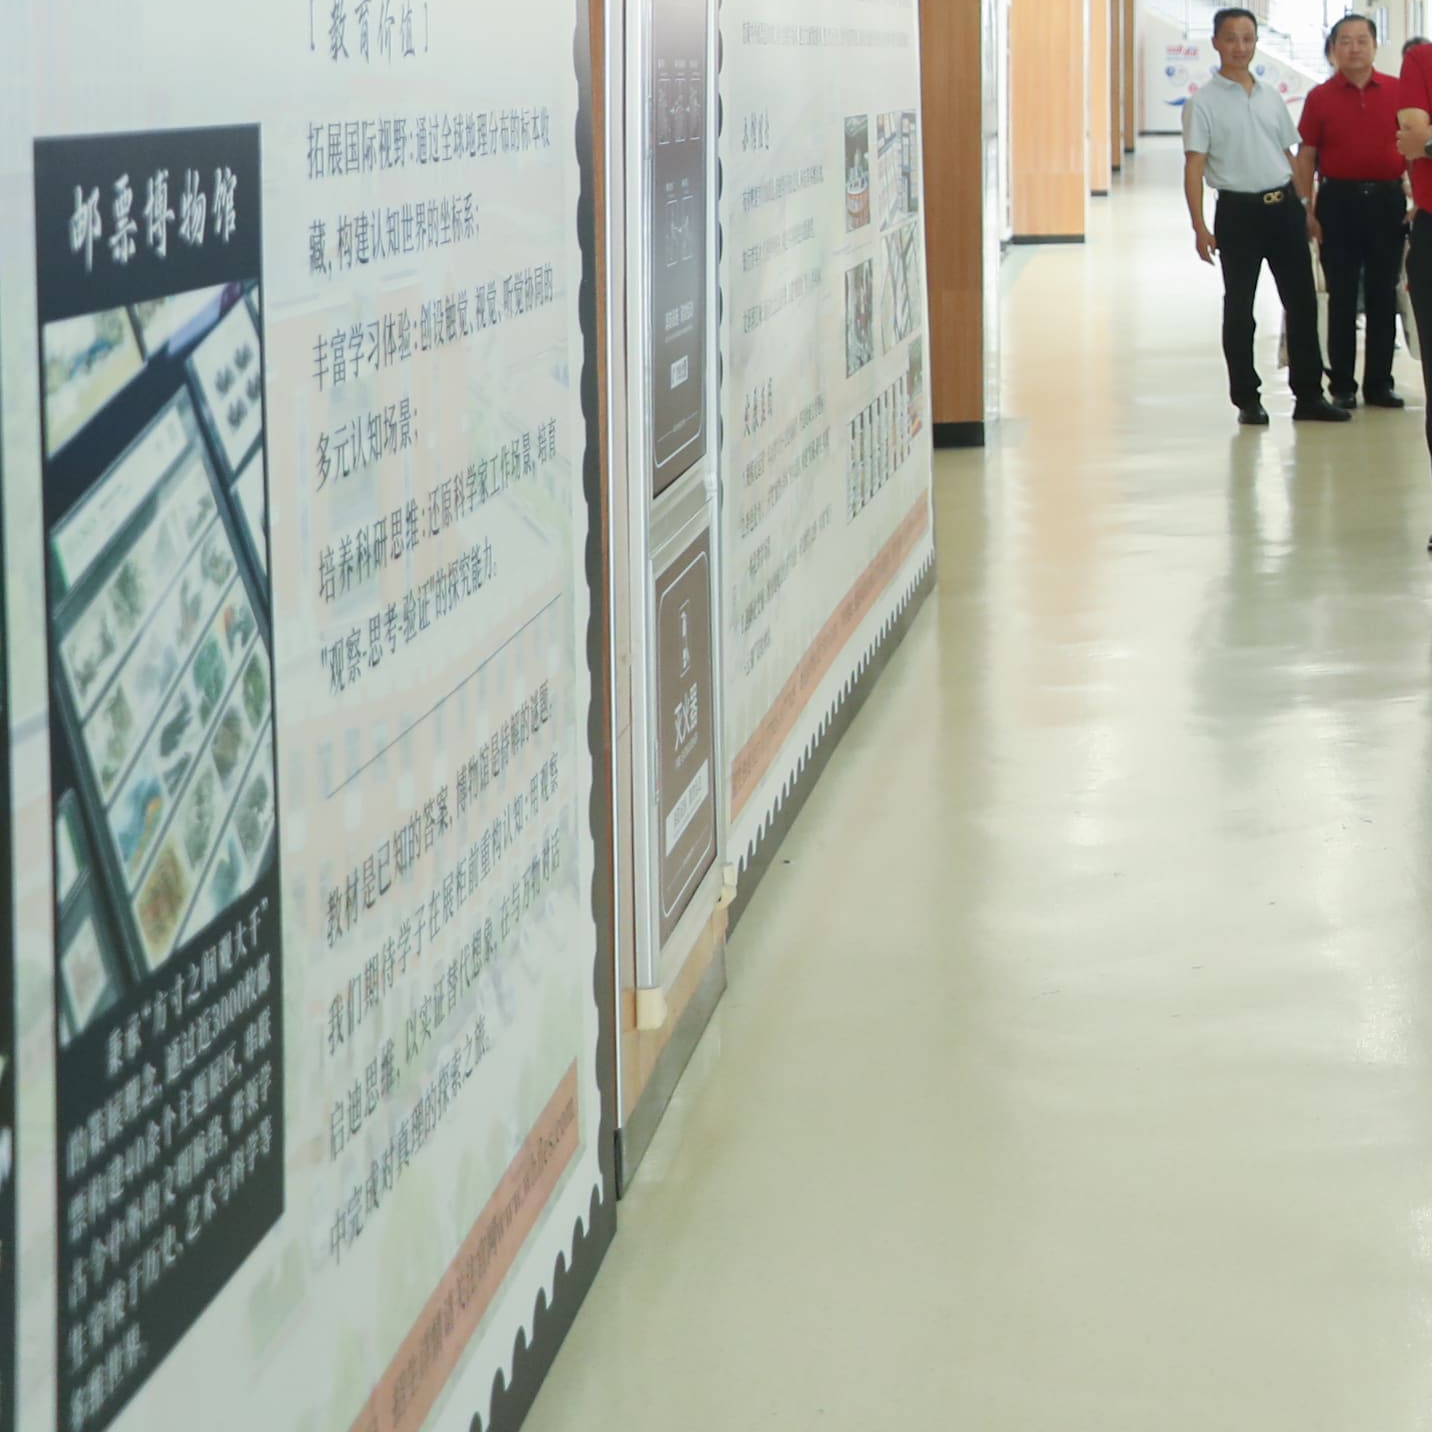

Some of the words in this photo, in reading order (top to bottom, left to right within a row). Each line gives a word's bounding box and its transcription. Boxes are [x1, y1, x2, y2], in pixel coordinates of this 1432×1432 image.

[68, 165, 239, 273] 邮票博物馆
